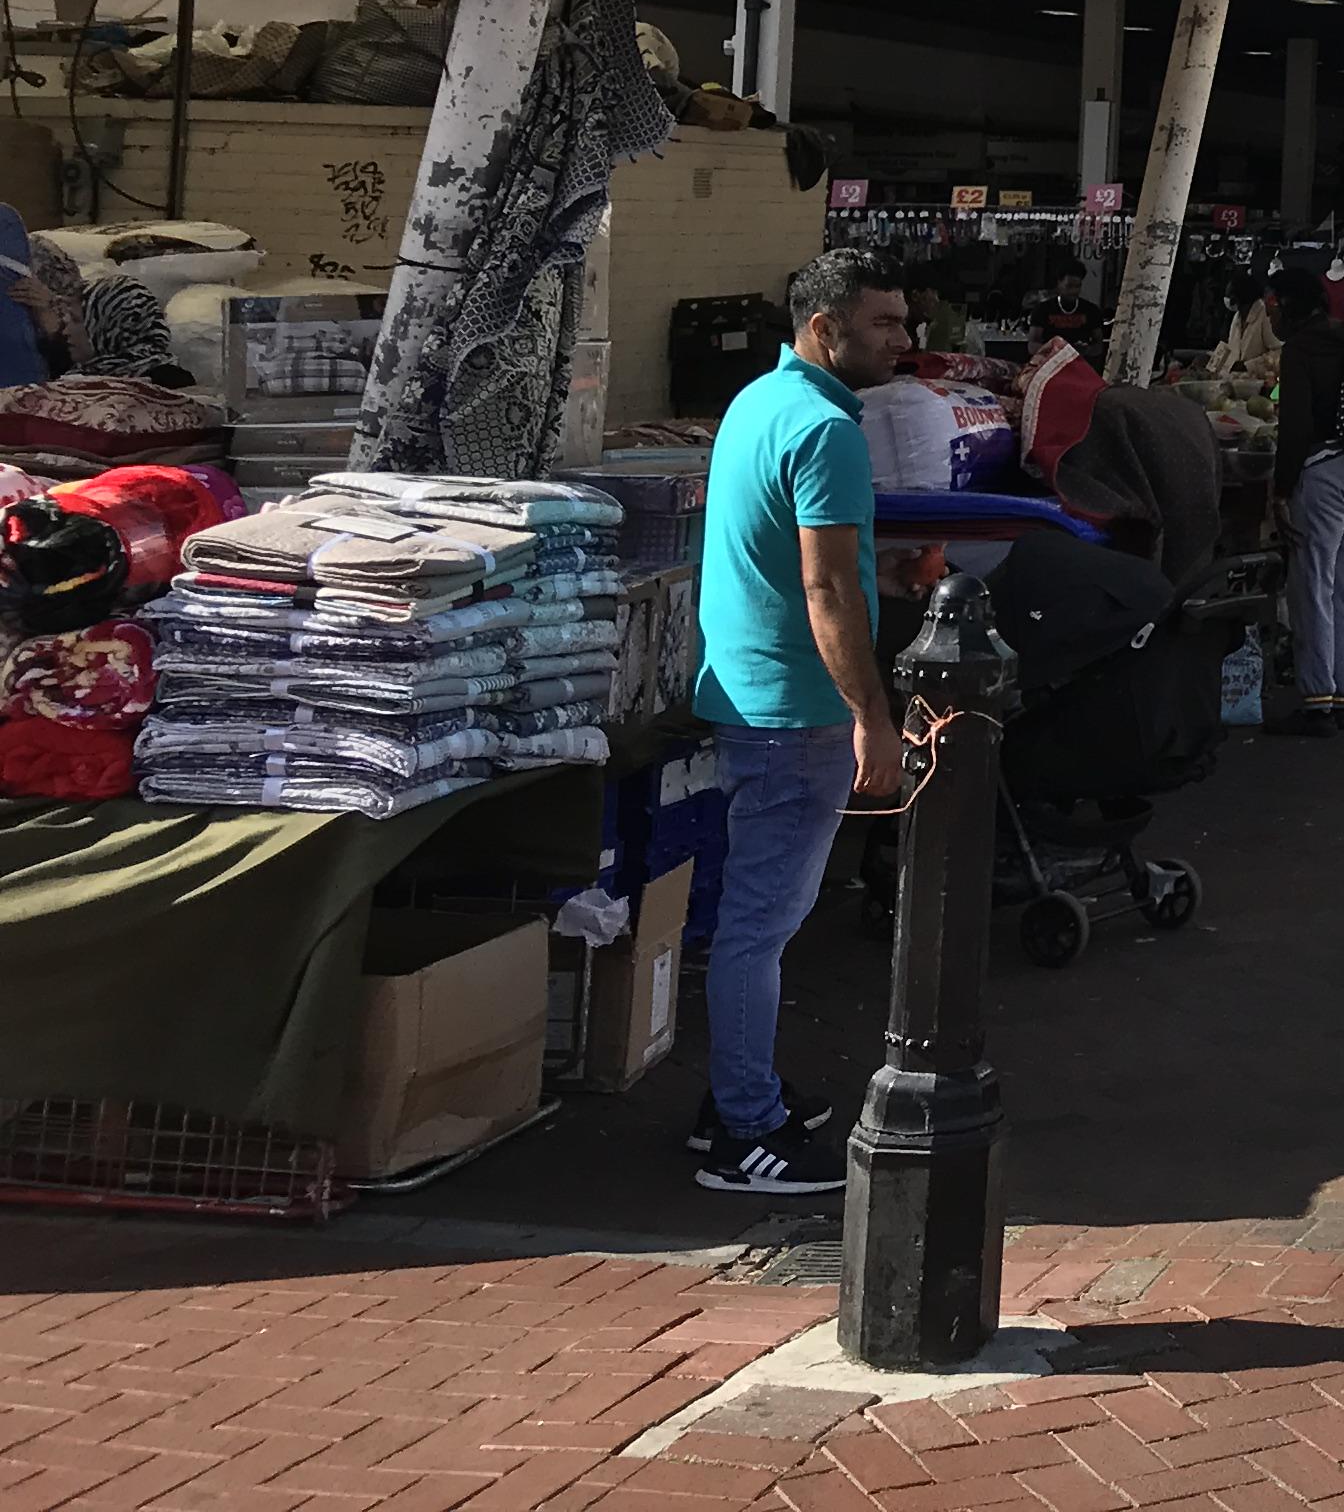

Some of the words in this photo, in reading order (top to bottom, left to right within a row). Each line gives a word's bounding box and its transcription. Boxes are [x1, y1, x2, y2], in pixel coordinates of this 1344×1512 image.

[839, 185, 861, 203] £2
[955, 189, 984, 205] £2
[1094, 188, 1116, 207] £2
[1220, 209, 1238, 228] £3
